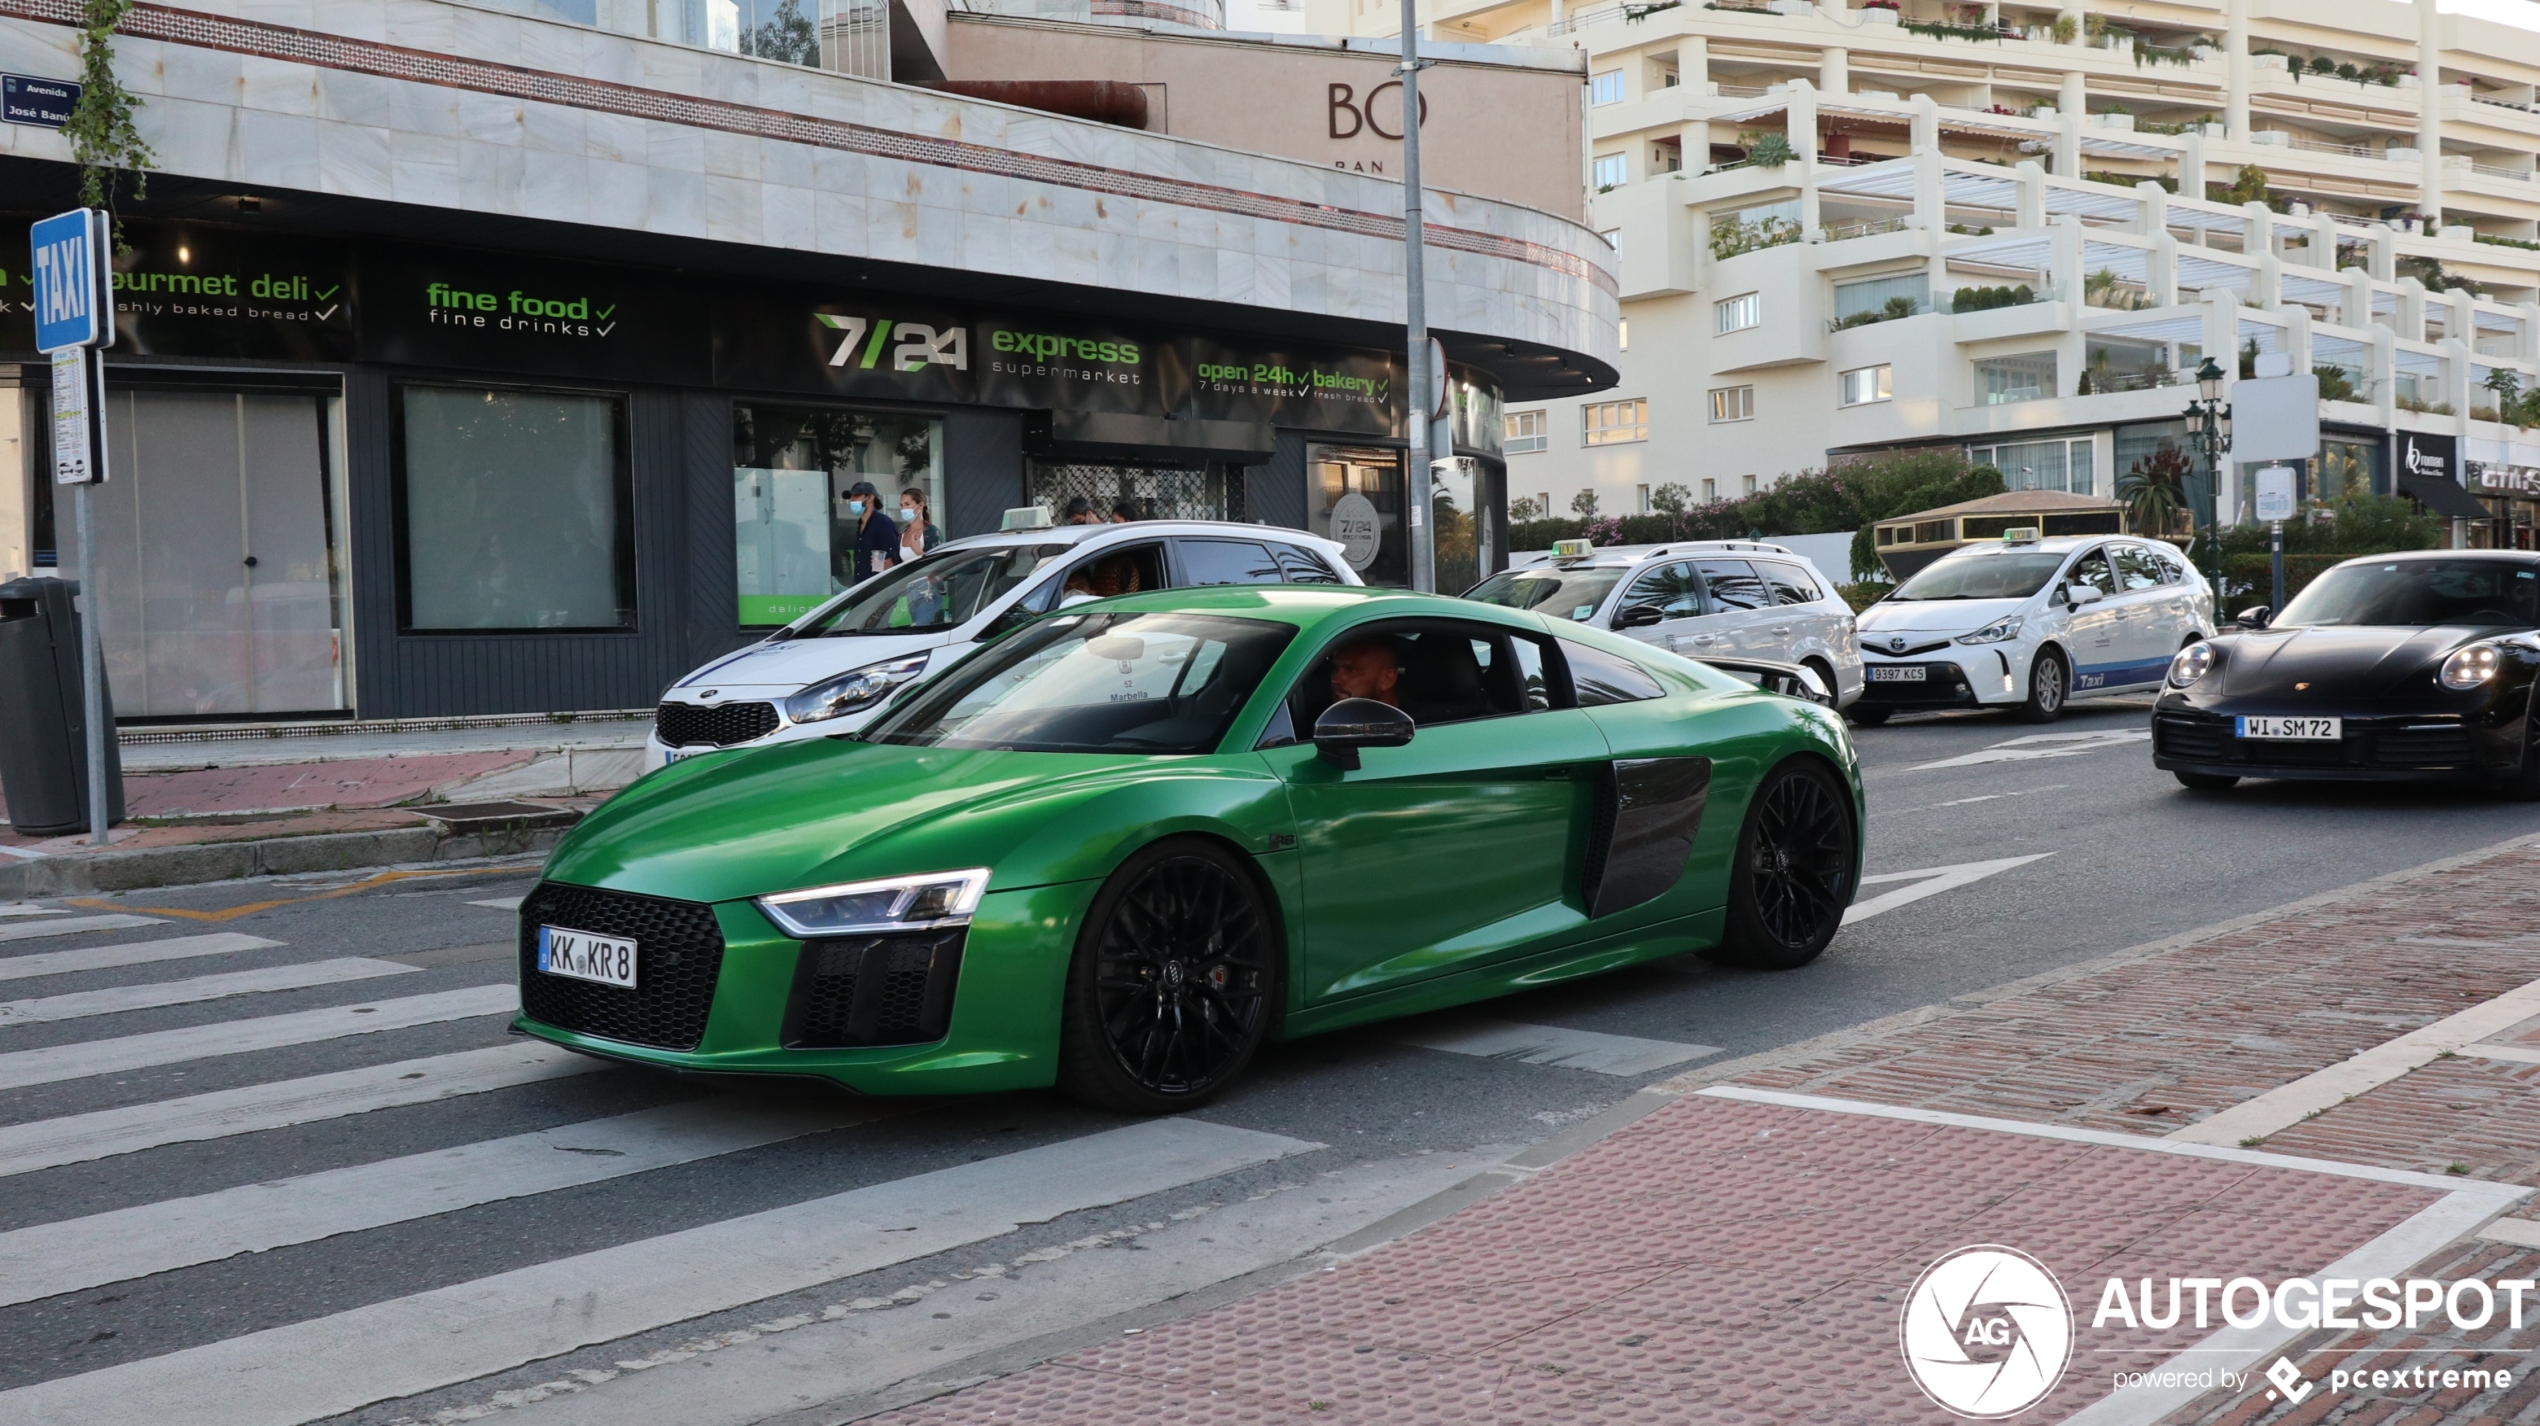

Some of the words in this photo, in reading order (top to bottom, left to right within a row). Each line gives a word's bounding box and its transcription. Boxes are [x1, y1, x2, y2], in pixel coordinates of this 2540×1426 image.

[26, 84, 68, 98] Avenida
[8, 105, 37, 118] José
[40, 110, 72, 122] Banú
[36, 236, 86, 326] TAXI
[112, 271, 238, 296] ourmet
[250, 273, 308, 301] deli
[426, 282, 498, 311] fine
[507, 290, 589, 320] food
[117, 301, 163, 316] shly
[173, 303, 238, 317] baked
[248, 307, 309, 321] bread
[429, 309, 486, 327] fine
[499, 315, 590, 337] drinks
[812, 312, 968, 373] 7/24
[991, 330, 1140, 364] express
[992, 360, 1141, 385] supermarket
[1198, 363, 1249, 383] open
[1253, 363, 1295, 385] 24h
[1199, 380, 1207, 390] 7
[1213, 382, 1245, 395] days
[1251, 386, 1258, 394] a
[1263, 387, 1295, 397] week
[1313, 369, 1376, 397] bakery
[1313, 390, 1342, 400] fresh
[1345, 393, 1375, 404] bread
[2420, 455, 2445, 468] roman
[1340, 519, 1372, 534] 7/24
[1560, 543, 1576, 556] TAXI
[1875, 668, 1901, 680] 9397
[1904, 668, 1924, 680] KCS
[2080, 673, 2105, 688] Taxi
[1124, 680, 1133, 688] 52
[1110, 690, 1149, 702] Marbella
[2249, 719, 2270, 735] WI
[2282, 720, 2305, 736] SM
[2309, 720, 2332, 737] 72
[550, 934, 575, 971] KK
[588, 940, 613, 979] KR
[617, 945, 630, 981] 8
